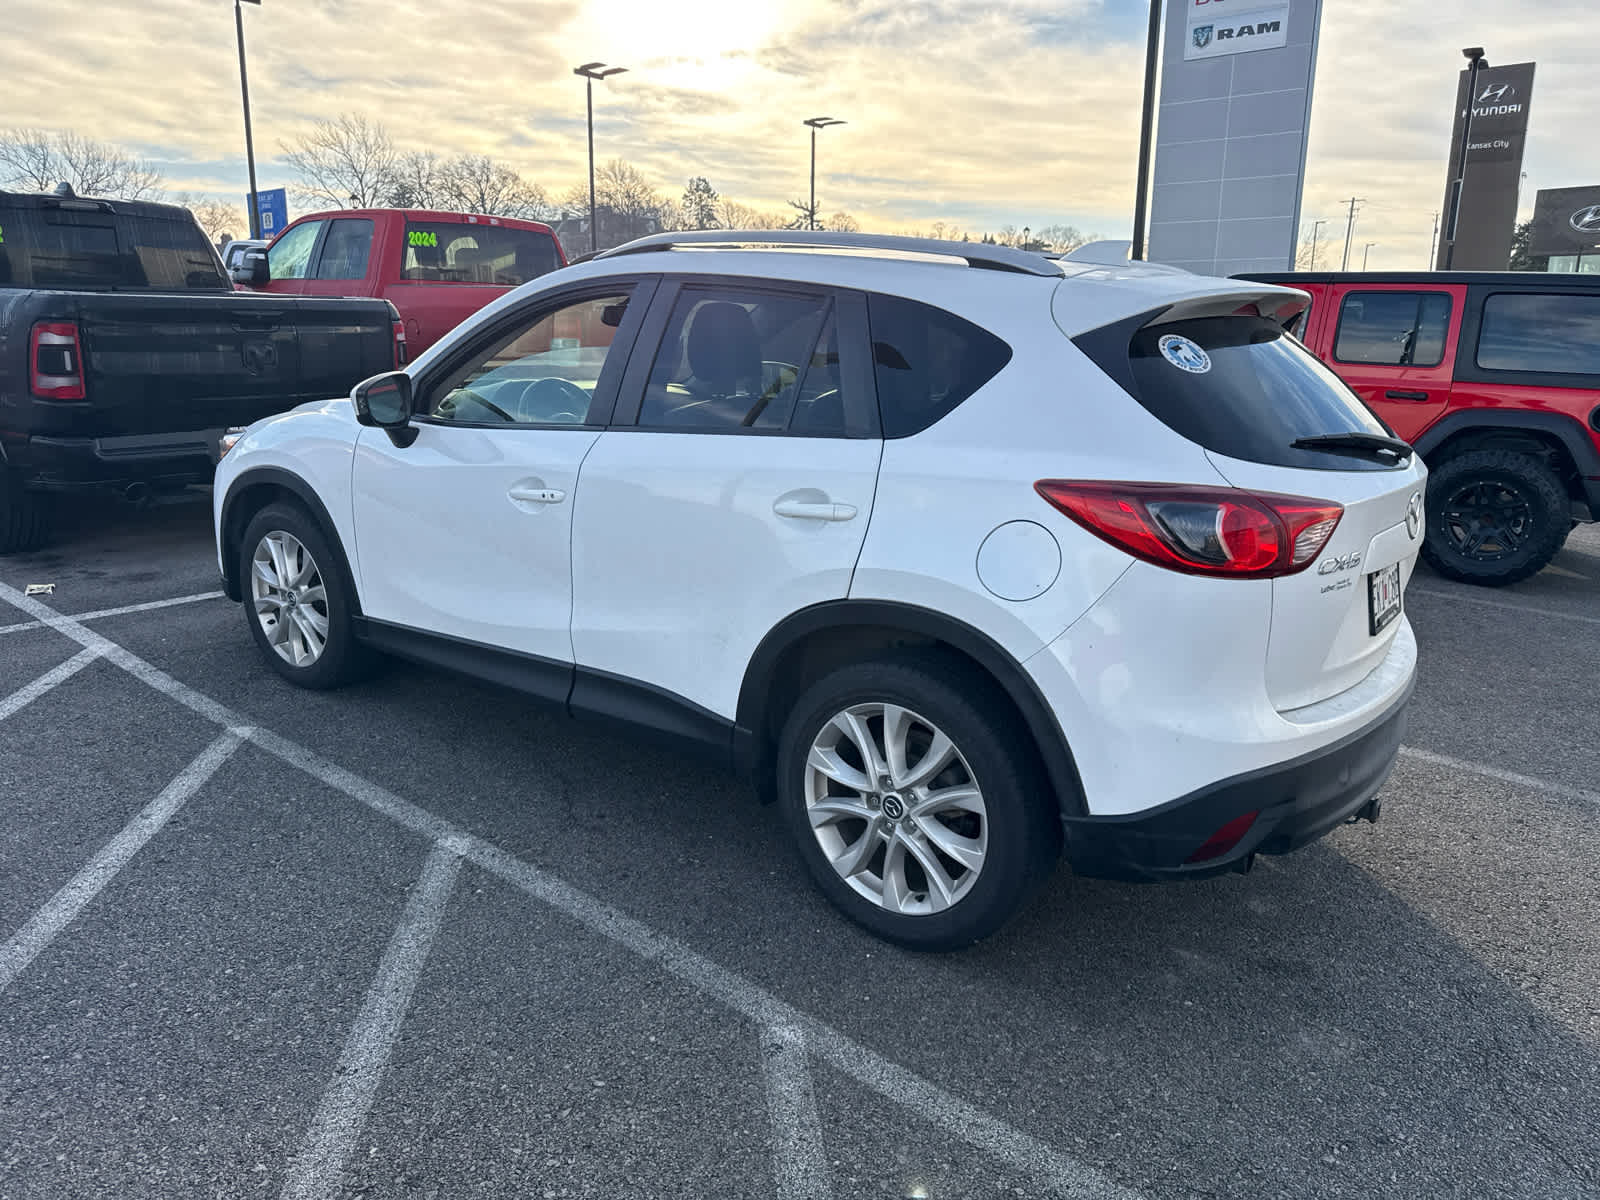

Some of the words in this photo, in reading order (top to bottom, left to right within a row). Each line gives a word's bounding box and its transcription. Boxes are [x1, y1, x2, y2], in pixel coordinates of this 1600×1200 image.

[1217, 21, 1280, 40] RAM
[1493, 140, 1510, 149] City
[408, 231, 438, 247] 2024
